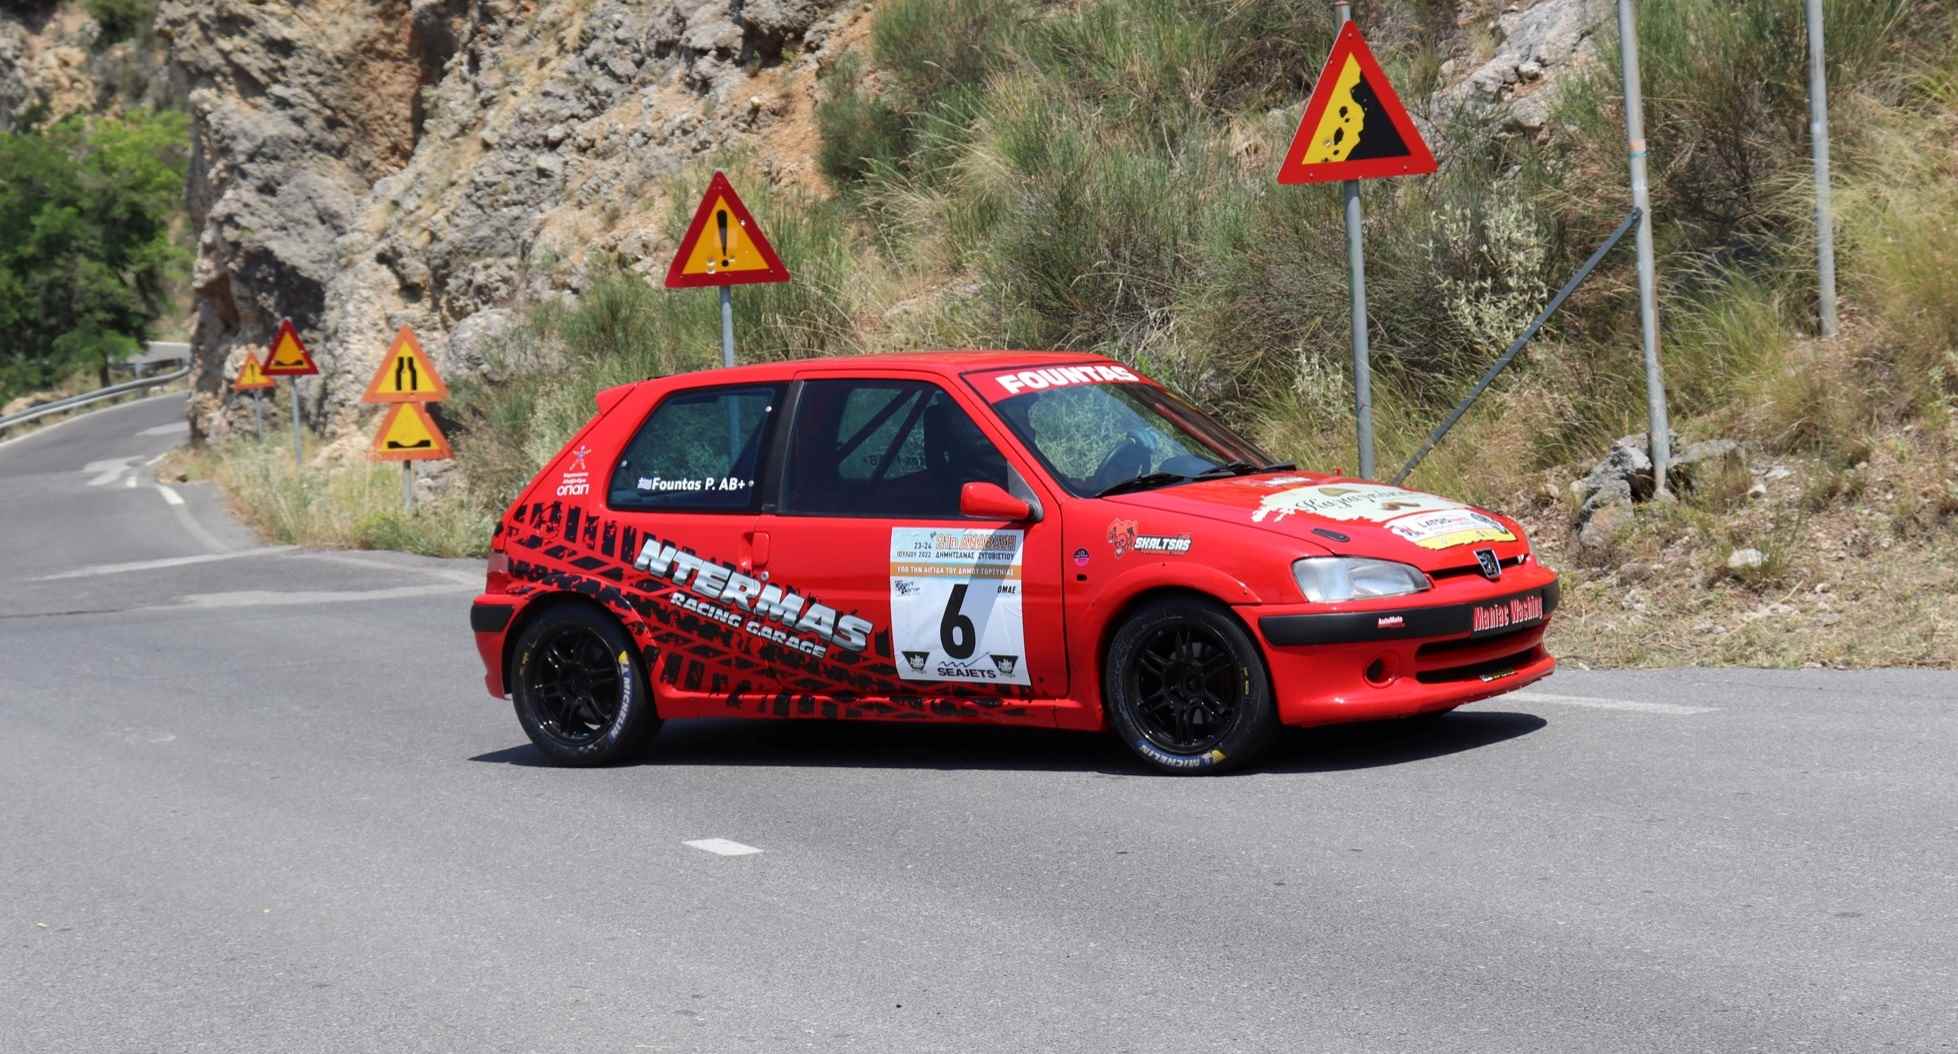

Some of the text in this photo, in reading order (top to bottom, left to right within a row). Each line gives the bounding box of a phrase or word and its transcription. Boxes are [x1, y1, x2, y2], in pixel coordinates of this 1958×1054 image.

[995, 366, 1139, 394] FOUNTAS
[652, 477, 746, 490] Fountas P. AB+
[1134, 536, 1192, 552] SKALTSAS
[634, 538, 873, 651] NTERMAS
[670, 592, 827, 659] RACING GARAGE
[940, 584, 976, 660] 6
[1473, 604, 1509, 633] Maniac
[937, 667, 997, 679] SEAJETS
[611, 676, 632, 739] MICHELIN
[1140, 744, 1200, 768] MICHELIN
